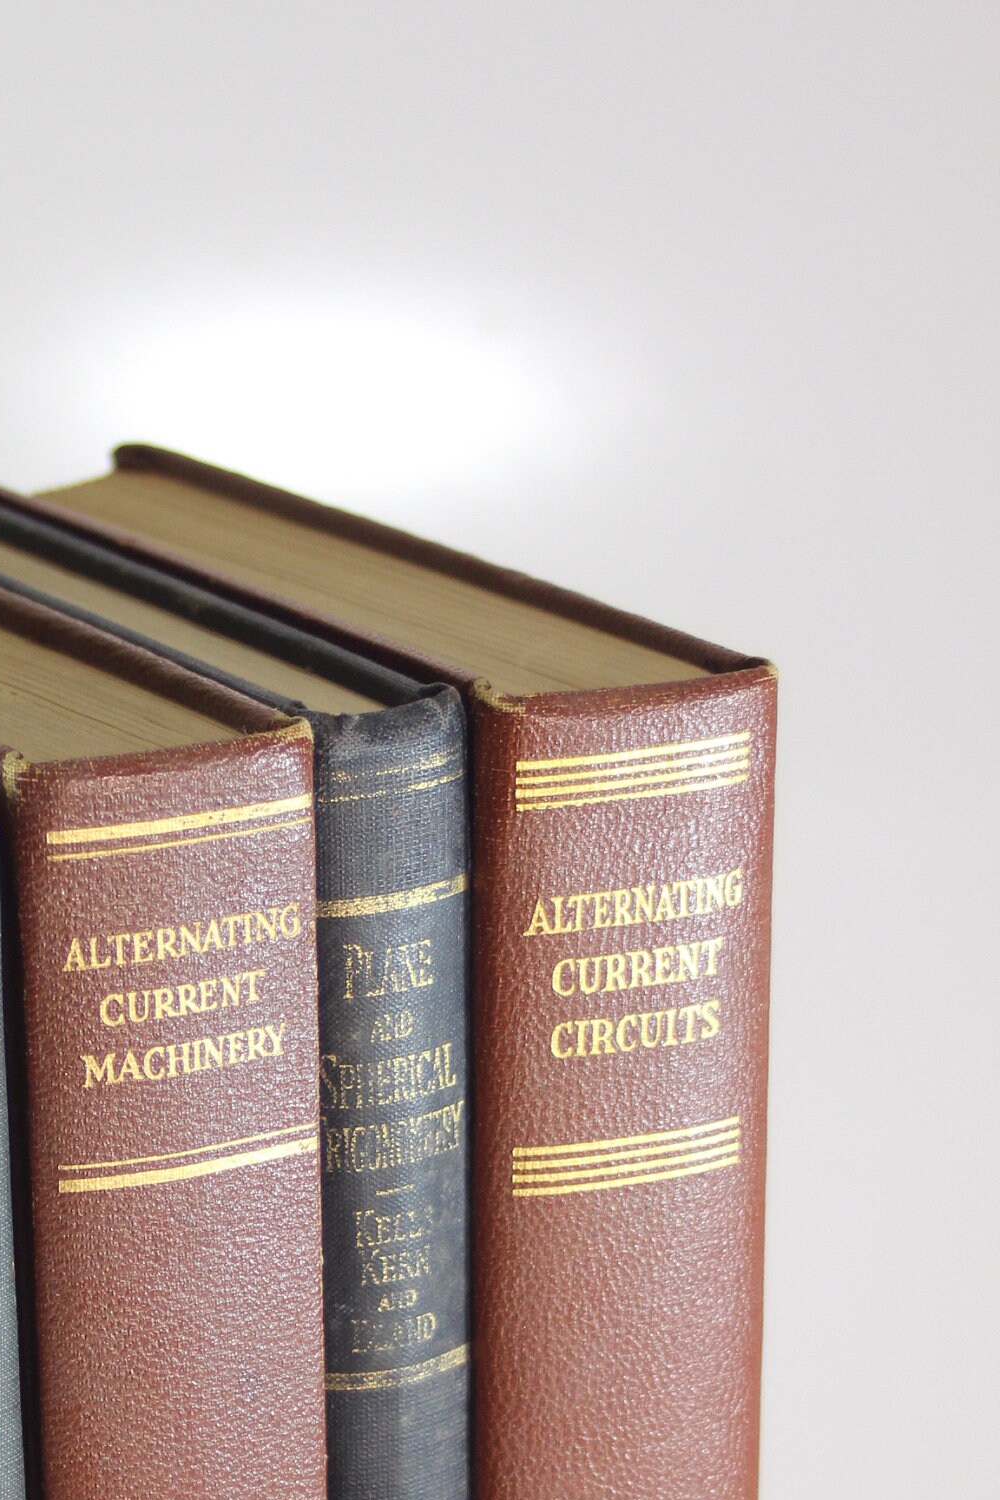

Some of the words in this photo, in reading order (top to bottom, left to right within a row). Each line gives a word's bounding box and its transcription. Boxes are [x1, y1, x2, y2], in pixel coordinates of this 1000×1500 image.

[522, 868, 745, 937] ALTERNATING
[62, 903, 302, 972] ALTERNATING
[550, 936, 724, 997] CURRENT
[99, 969, 267, 1026] CURRENT
[549, 999, 721, 1060] CIRCUITS
[81, 1022, 288, 1089] MACHINERY
